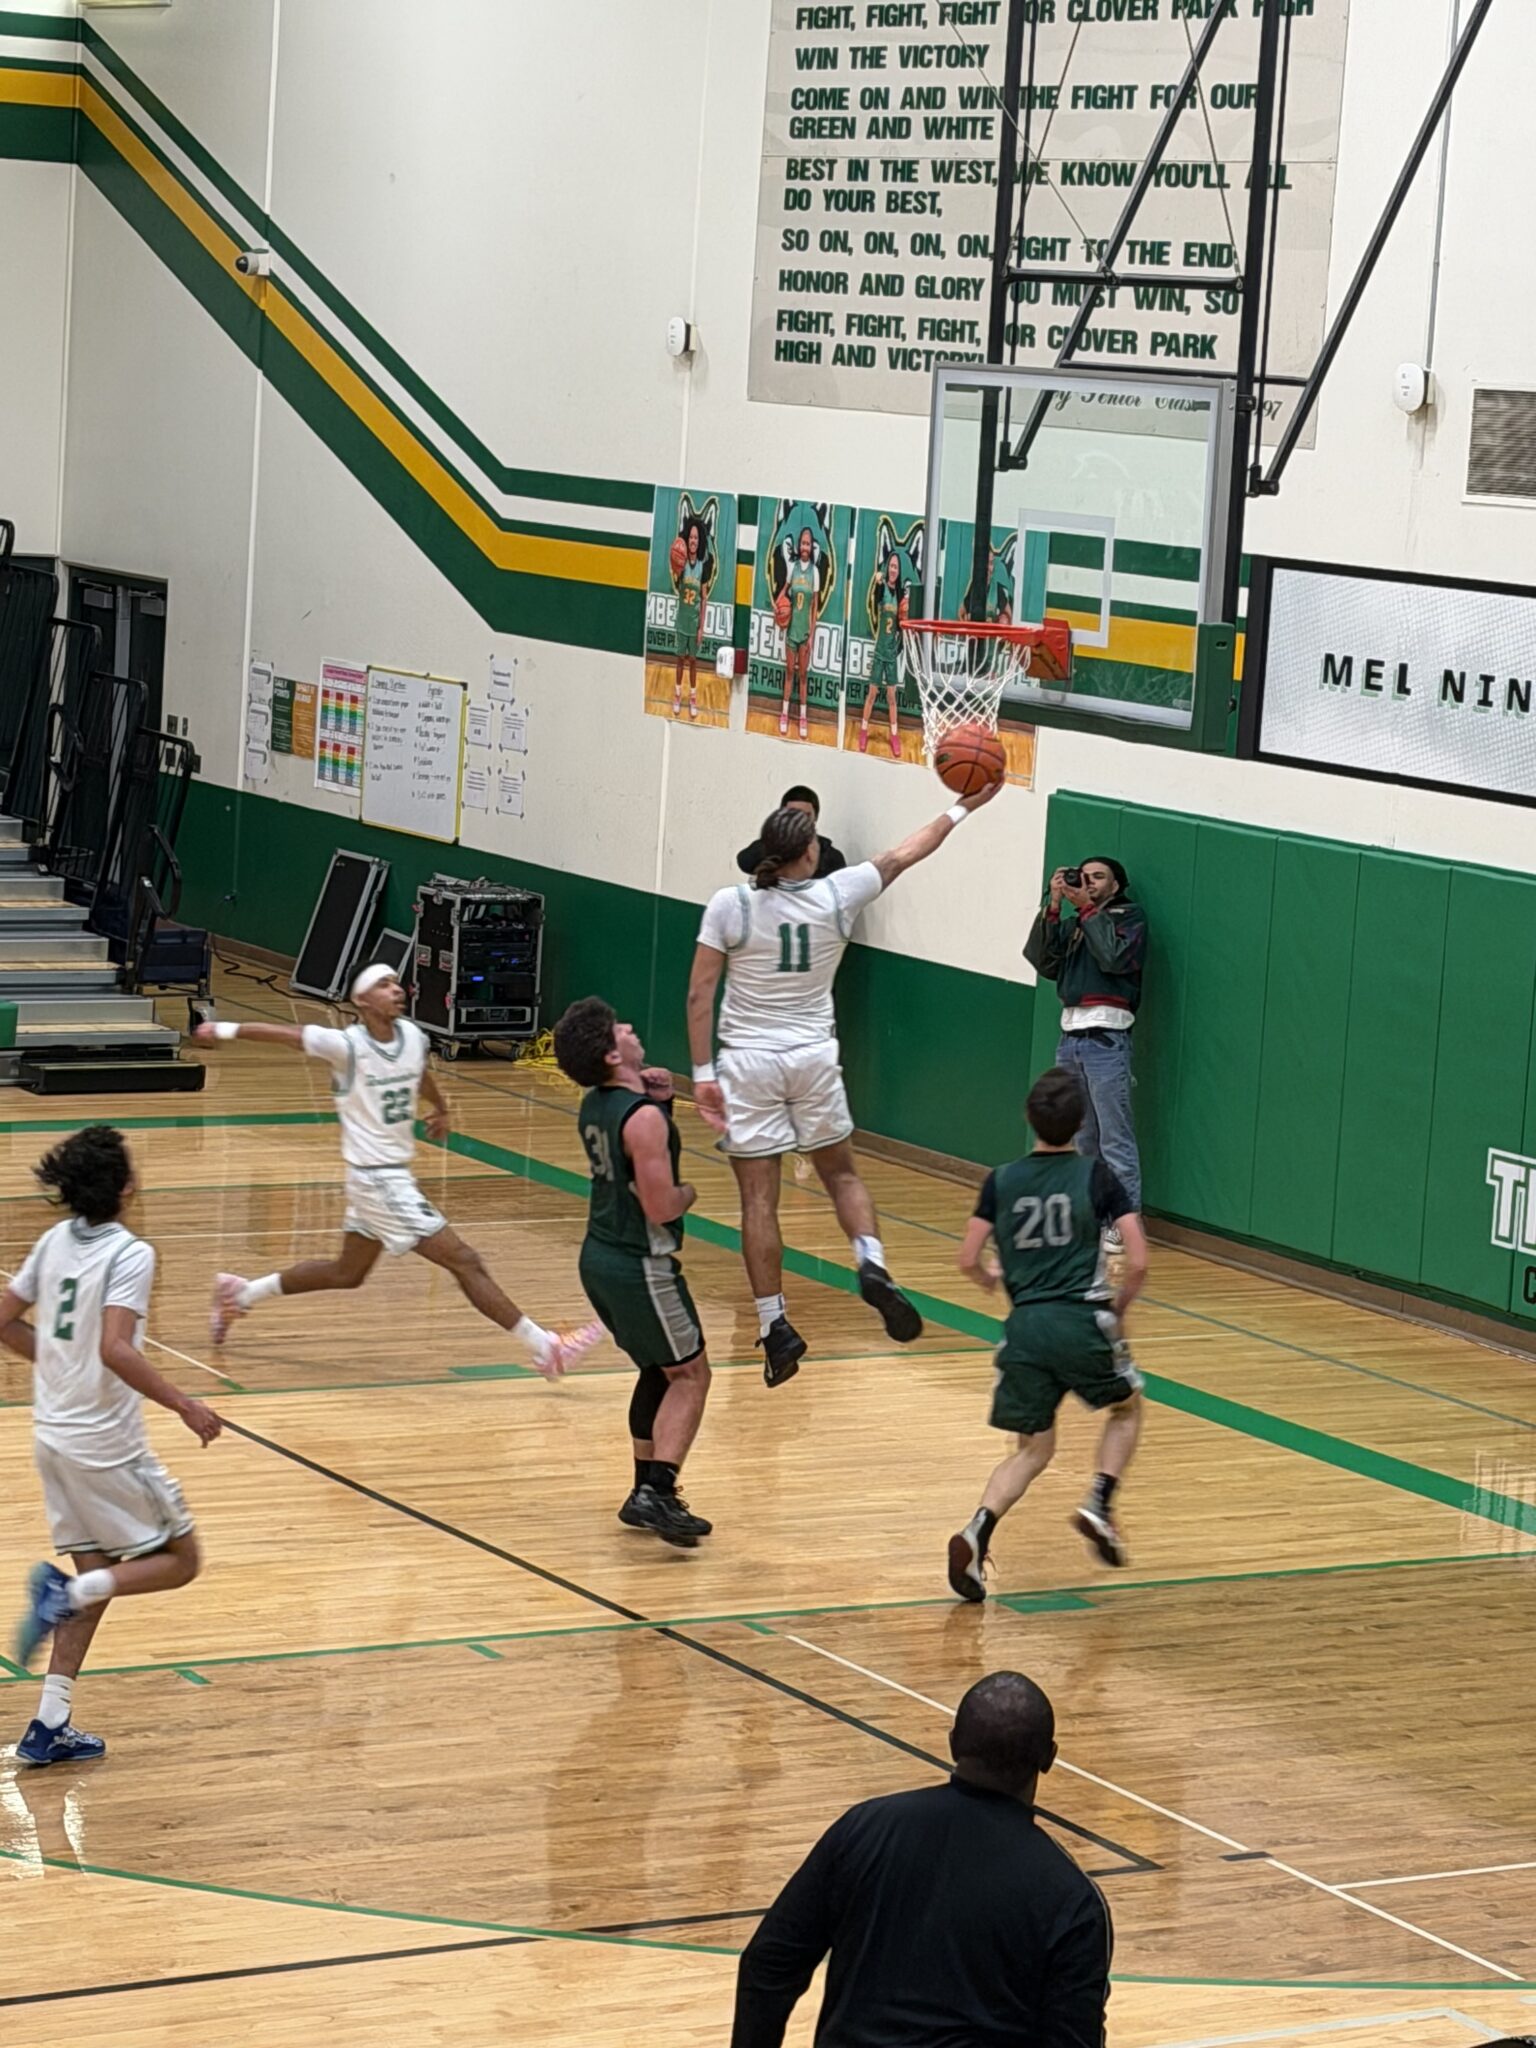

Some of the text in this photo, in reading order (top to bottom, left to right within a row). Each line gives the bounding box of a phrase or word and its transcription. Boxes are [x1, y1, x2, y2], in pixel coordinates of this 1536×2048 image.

[795, 6, 856, 31] FIGHT,
[866, 2, 928, 29] FIGHT,
[1023, 0, 1055, 23] OR
[1067, 0, 1158, 21] CLOVER
[795, 44, 990, 70] WIN THE VICTORY
[790, 87, 850, 111] COME
[860, 86, 889, 110] ON
[901, 86, 947, 110] AND
[958, 85, 1006, 110] WIN
[1018, 85, 1060, 110] THE
[1071, 84, 1138, 110] FIGHT
[789, 116, 995, 140] GREEN AND WHITE
[786, 158, 837, 181] BEST
[847, 158, 869, 181] IN
[880, 159, 920, 183] THE
[931, 159, 998, 187] WEST,
[1060, 162, 1137, 187] KNOW
[1151, 162, 1230, 189] YOU'LL
[783, 187, 942, 217] DO YOUR BEST,
[781, 228, 809, 252] SO
[819, 229, 853, 255] ON,
[864, 231, 899, 257] ON,
[910, 232, 946, 259] ON,
[957, 234, 994, 261] ON,
[1126, 239, 1171, 266] THE
[778, 269, 849, 295] HONOR
[859, 272, 905, 297] AND
[914, 275, 985, 301] GLORY
[1133, 287, 1191, 315] WIN,
[1204, 290, 1240, 315] SO
[776, 309, 835, 338] FIGHT,
[845, 312, 907, 342] FIGHT,
[917, 316, 982, 347] FIGHT,
[1150, 332, 1218, 360] PARK
[774, 339, 822, 365] HIGH
[832, 343, 876, 369] AND
[776, 922, 811, 972] 11
[1011, 1193, 1073, 1250] 20
[54, 1277, 79, 1341] 2
